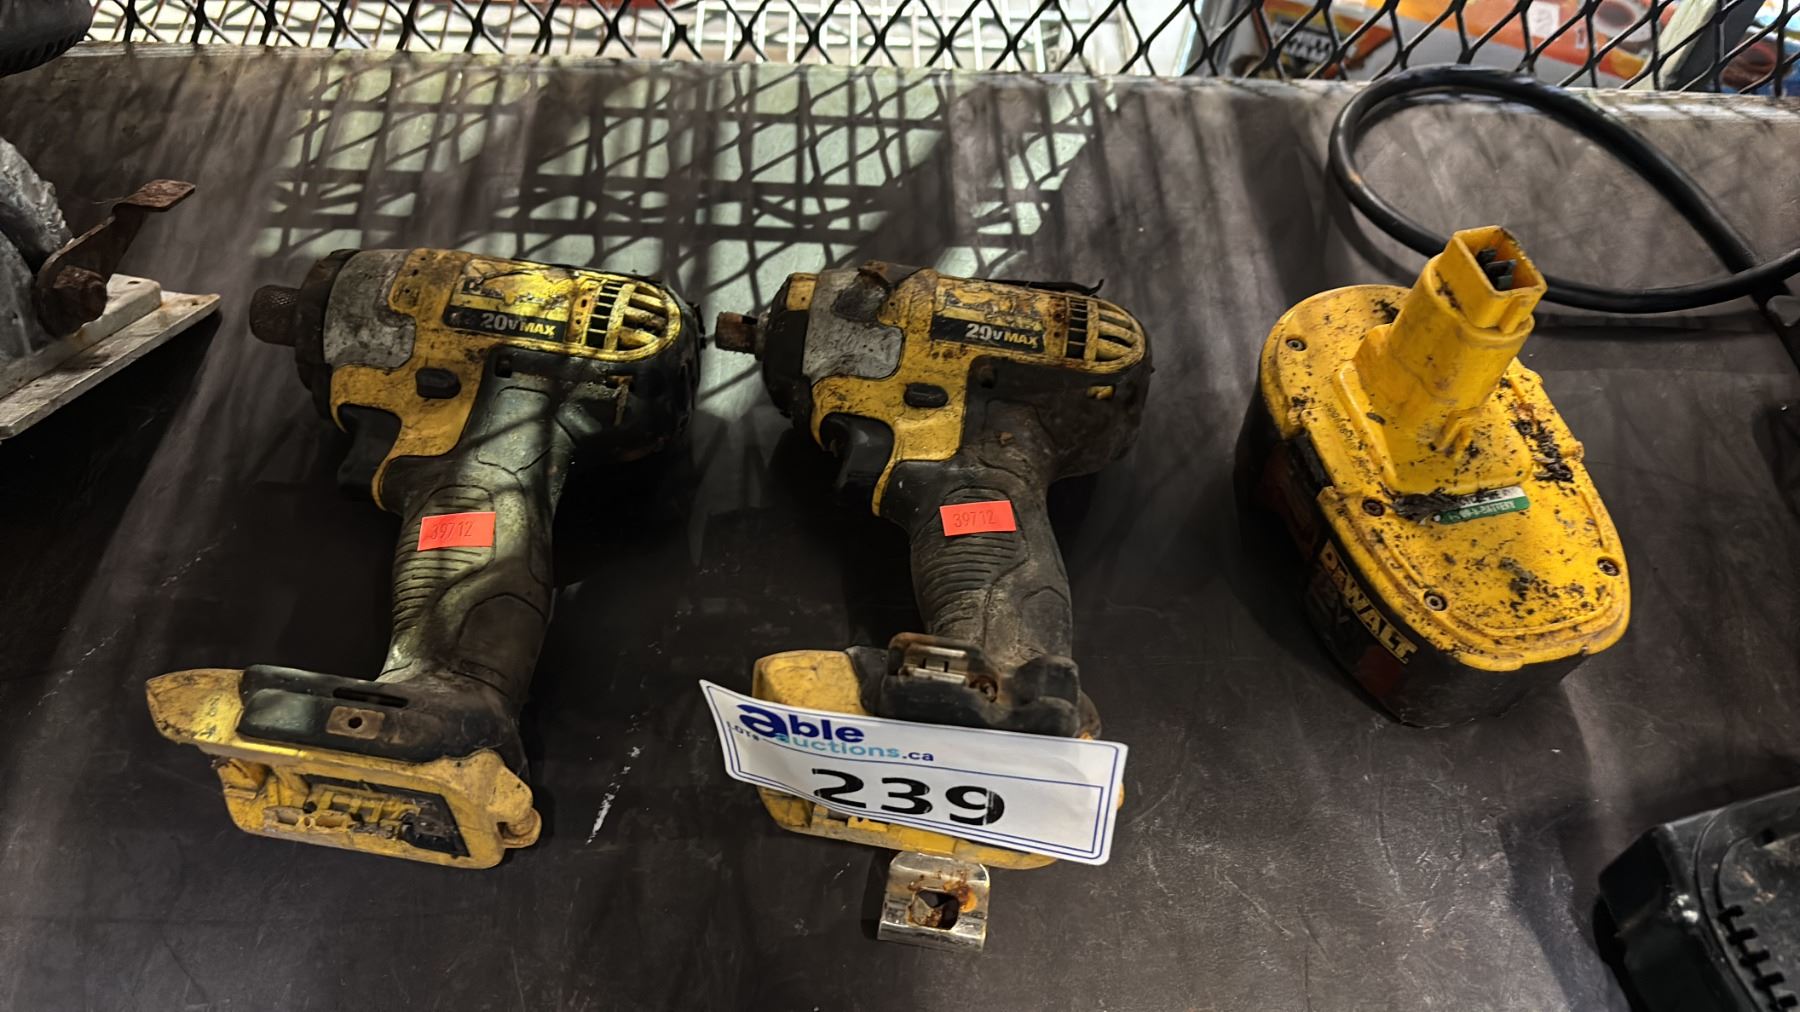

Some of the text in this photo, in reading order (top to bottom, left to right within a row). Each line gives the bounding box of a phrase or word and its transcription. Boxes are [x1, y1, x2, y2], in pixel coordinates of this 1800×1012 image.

[520, 321, 556, 336] MAX
[1004, 331, 1038, 346] MAX
[953, 509, 998, 528] 39712
[431, 520, 474, 539] 39712
[1320, 539, 1418, 664] DEWALT
[737, 704, 864, 743] able
[812, 768, 1005, 826] 239
